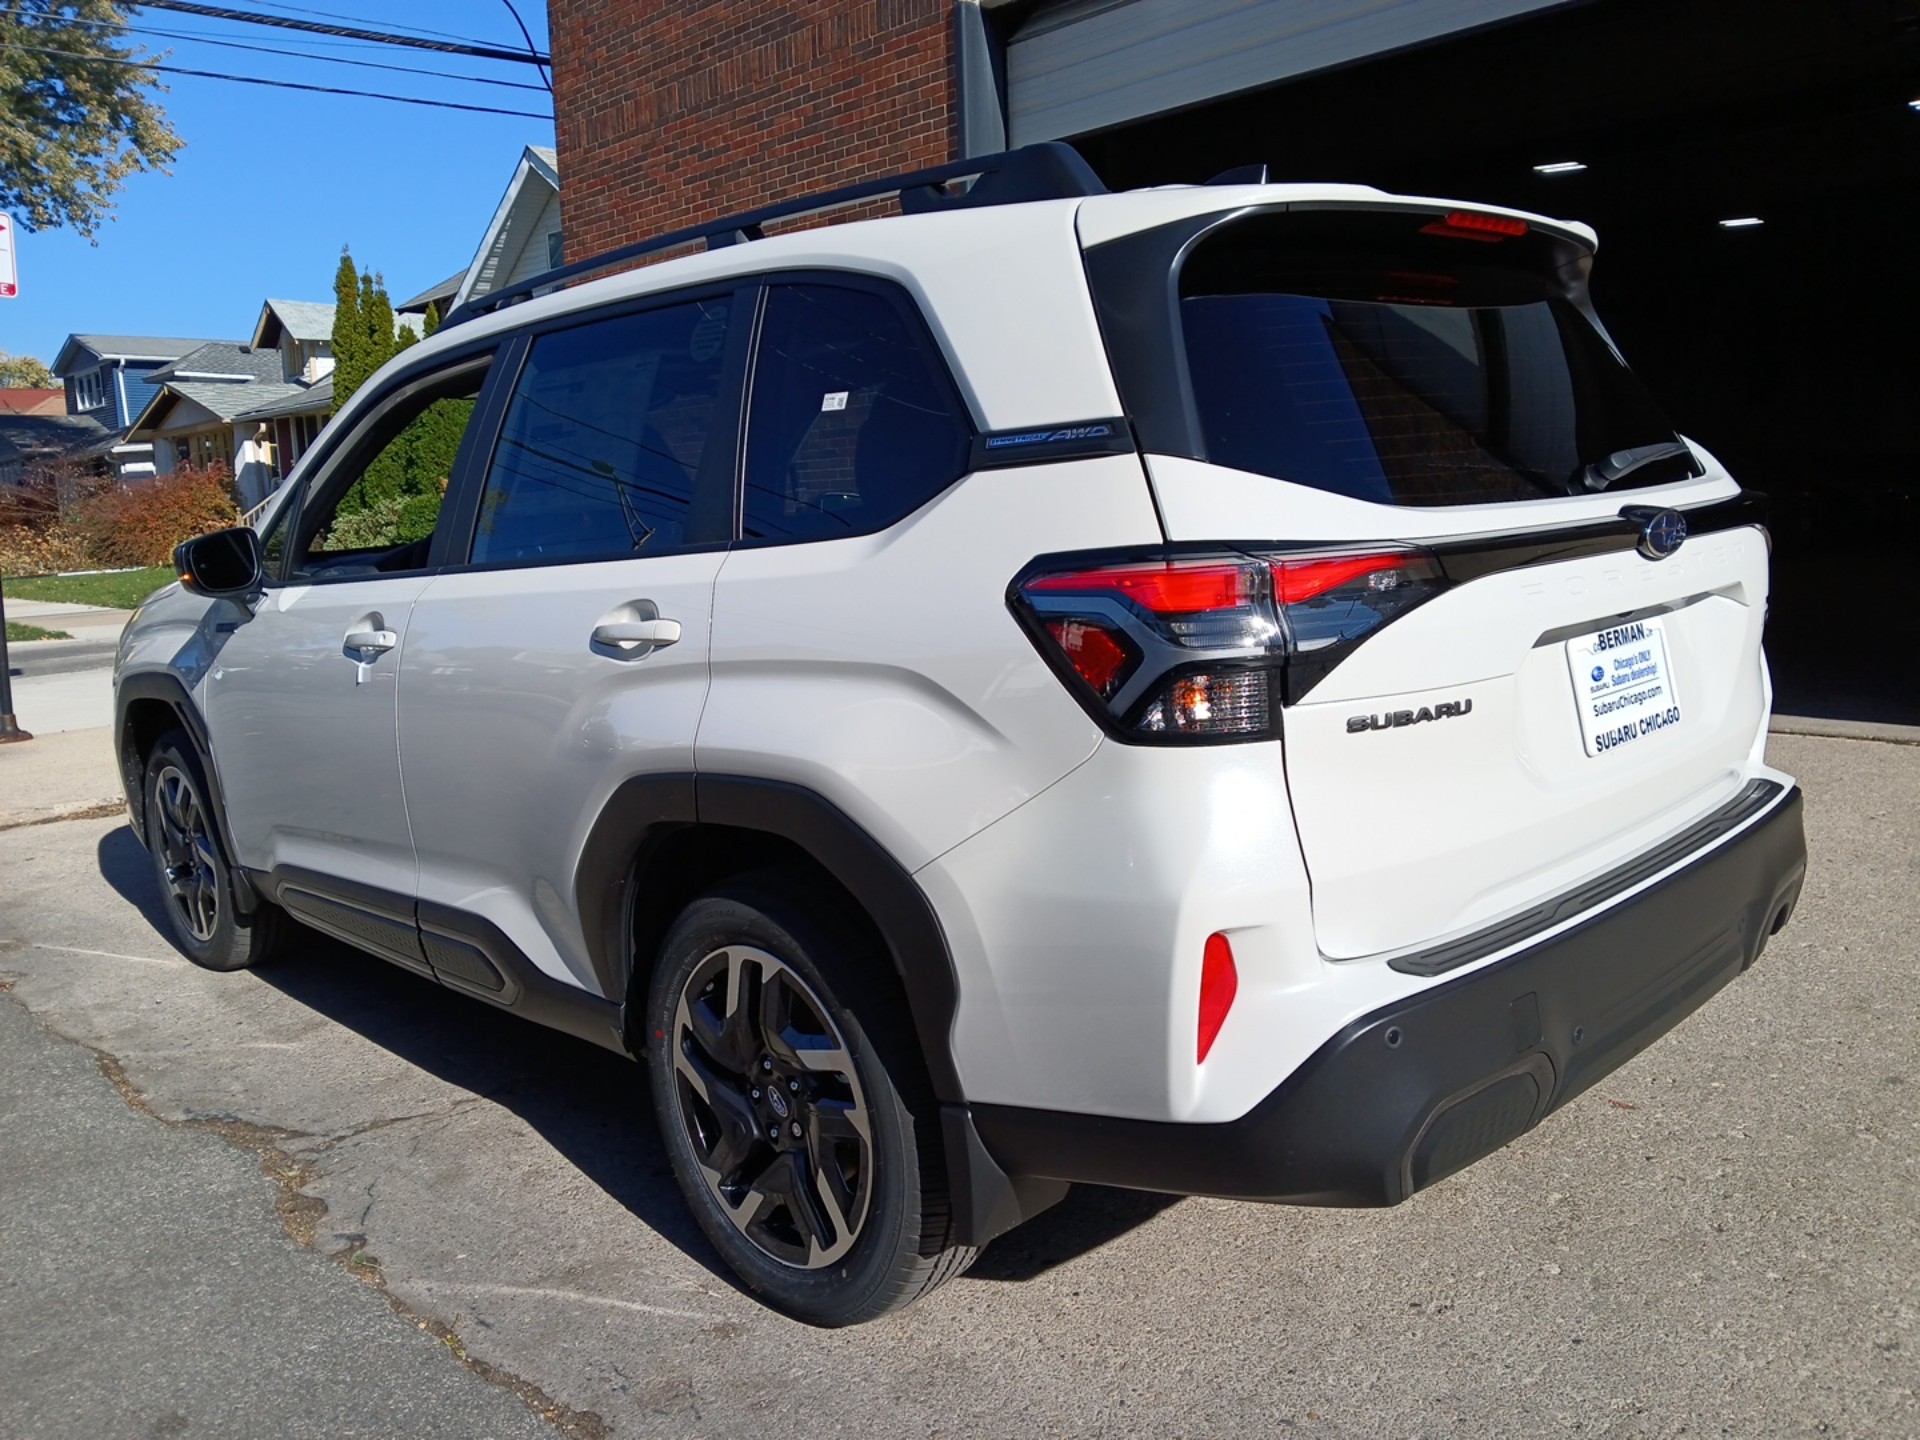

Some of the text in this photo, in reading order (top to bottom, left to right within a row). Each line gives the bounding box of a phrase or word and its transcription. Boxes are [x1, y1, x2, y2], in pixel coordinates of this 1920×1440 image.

[1048, 425, 1109, 441] AWD
[1520, 542, 1745, 596] FORESTER
[1598, 622, 1645, 651] BERMAN
[1613, 650, 1651, 671] Chicago's ONLY
[1590, 682, 1610, 694] SUBARU
[1611, 671, 1631, 687] Subaru
[1593, 685, 1663, 717] SubaruChicago.com
[1346, 698, 1472, 734] SUBARU
[1595, 706, 1681, 752] SUBARU CHICAGO
